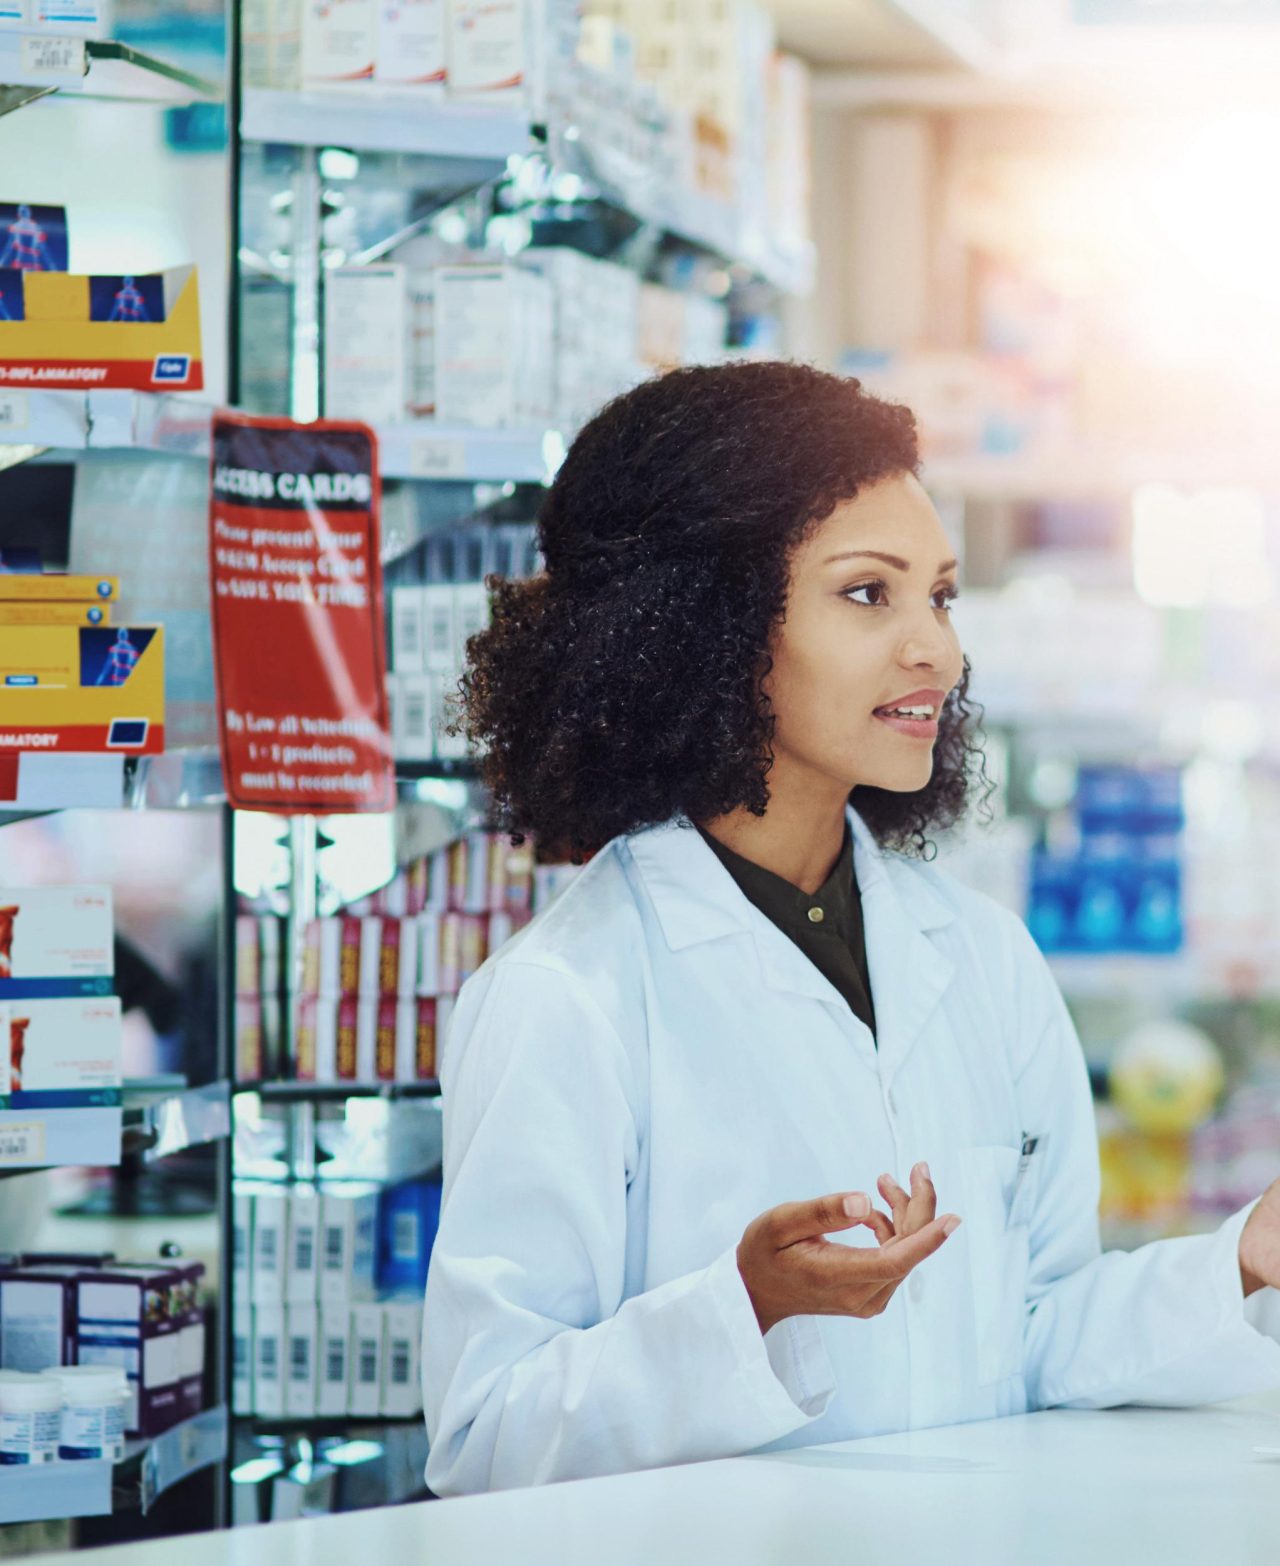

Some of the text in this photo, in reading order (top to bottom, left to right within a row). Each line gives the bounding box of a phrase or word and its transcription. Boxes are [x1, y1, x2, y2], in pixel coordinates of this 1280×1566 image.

[277, 473, 371, 502] CARDS
[251, 527, 313, 547] present
[282, 744, 356, 766] products
[241, 773, 275, 790] must
